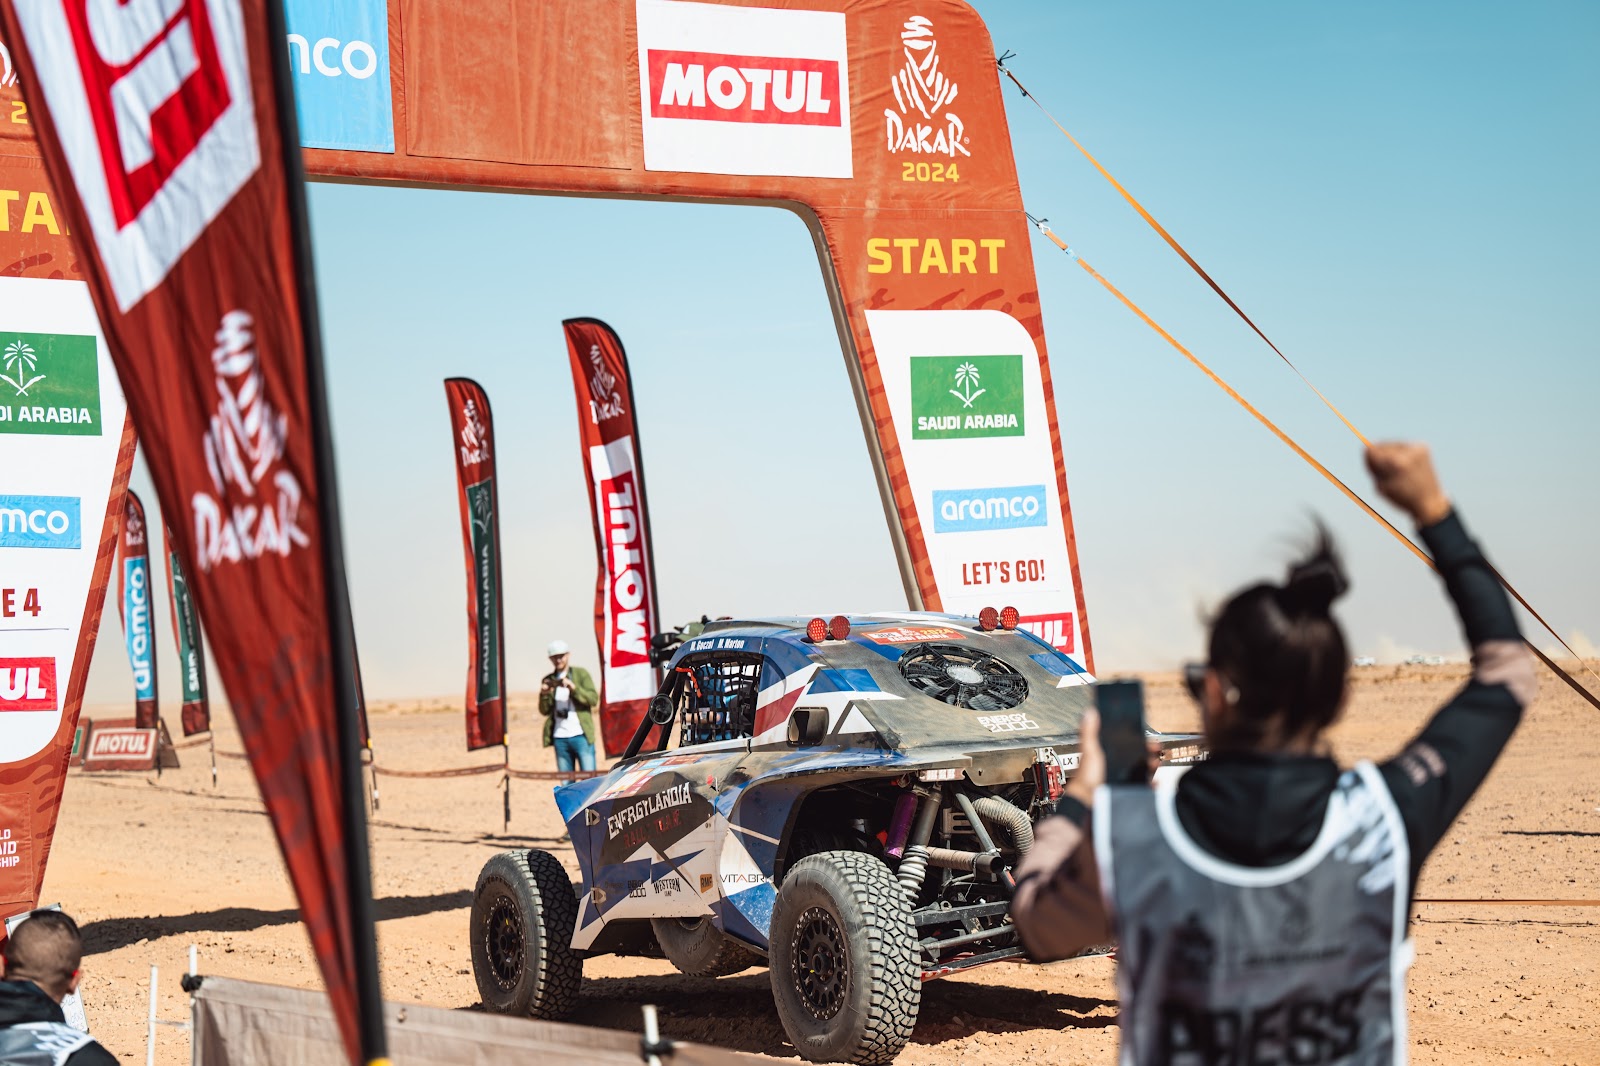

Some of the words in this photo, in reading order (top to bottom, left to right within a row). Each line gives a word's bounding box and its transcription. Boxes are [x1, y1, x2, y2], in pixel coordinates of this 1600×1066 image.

[660, 62, 832, 115] MOTUL
[884, 109, 971, 158] DAKAR
[902, 162, 960, 183] 2024
[0, 189, 71, 236] TA
[866, 238, 1006, 275] START
[17, 406, 93, 424] ARABIA
[589, 393, 625, 426] DAKAR
[917, 415, 961, 431] SAUDI
[963, 413, 1019, 430] ARABIA
[192, 469, 311, 574] DAKAR
[941, 495, 1039, 521] aramco
[608, 481, 648, 656] MOTUL
[962, 562, 1010, 586] LET'S
[1015, 559, 1046, 583] GO!
[23, 587, 42, 617] 4
[131, 566, 151, 691] aramco
[976, 712, 1028, 726] ENERGY
[983, 719, 1040, 733] 2000
[95, 734, 146, 753] MOTUL
[653, 877, 682, 894] WESTERN
